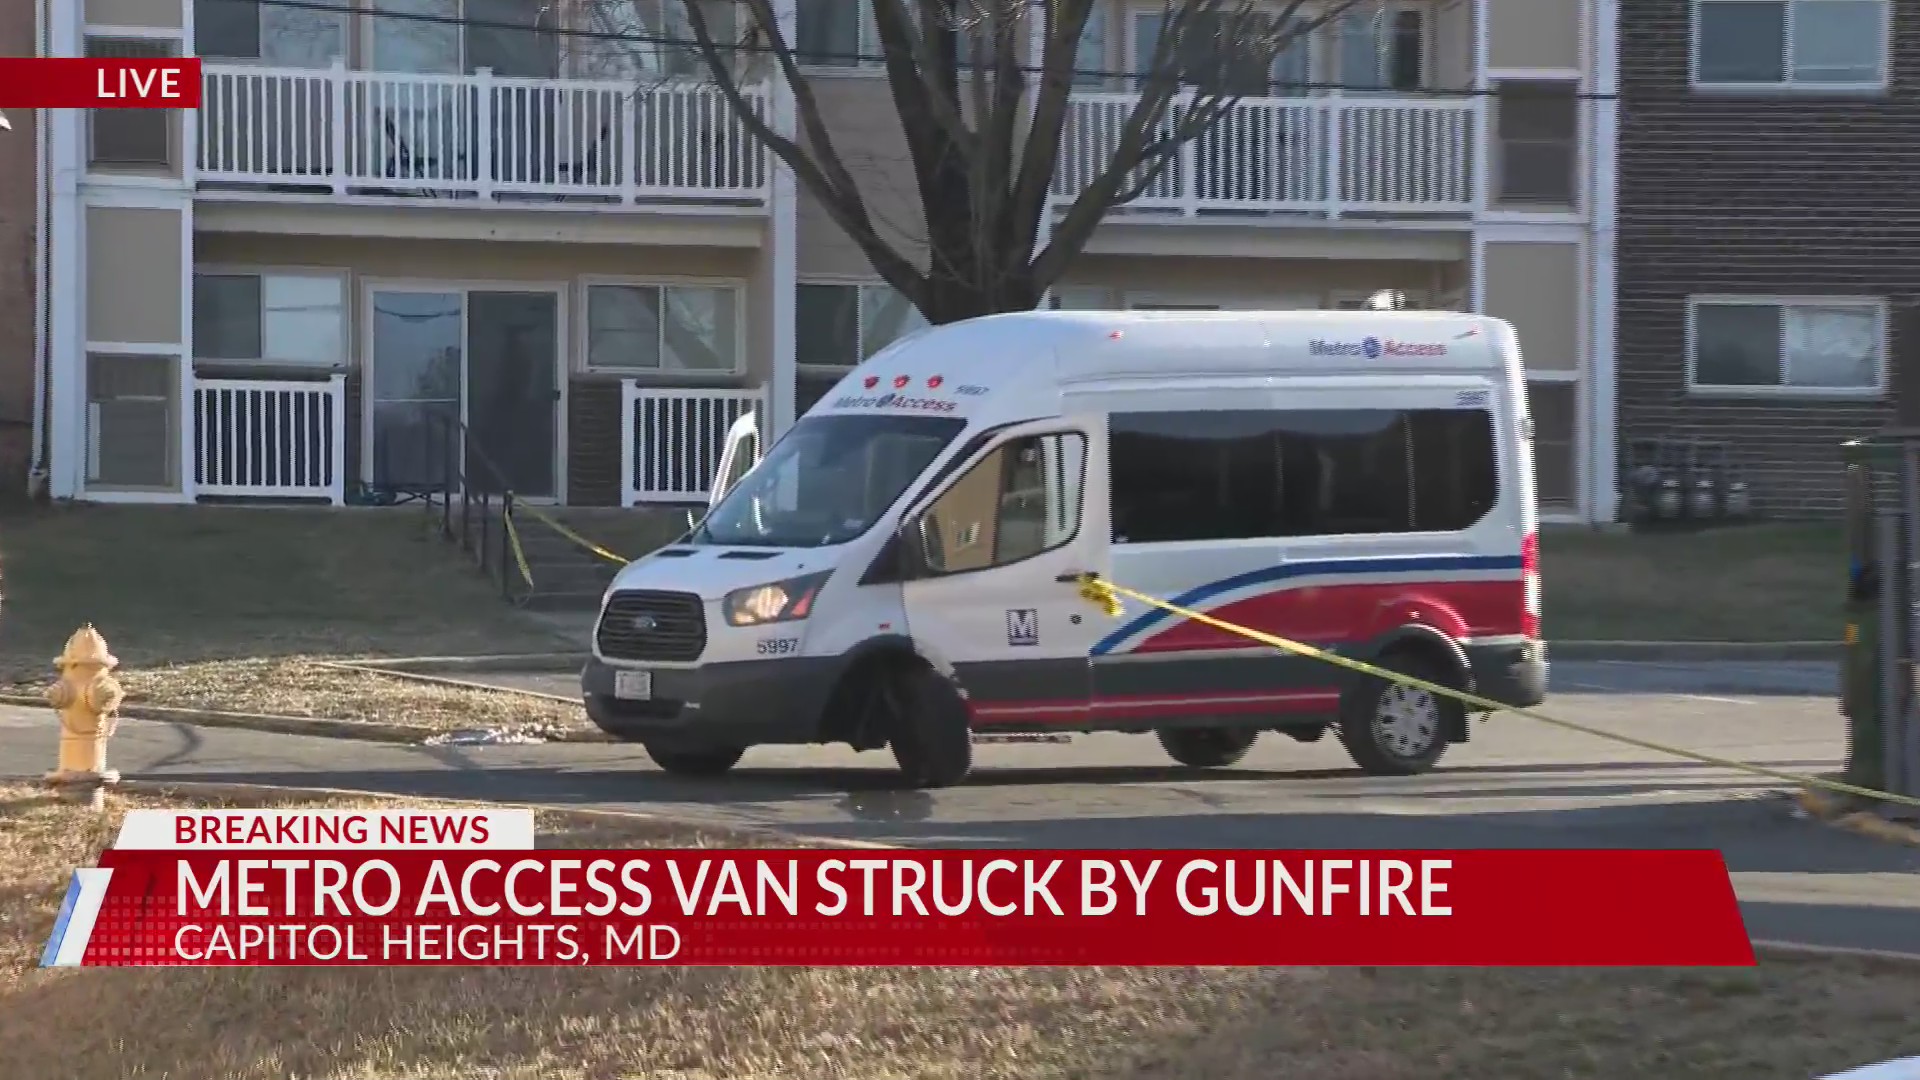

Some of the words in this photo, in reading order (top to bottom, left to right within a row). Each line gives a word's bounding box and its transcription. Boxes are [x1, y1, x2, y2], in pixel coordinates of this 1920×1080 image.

[1309, 338, 1362, 356] Metro
[1384, 338, 1447, 356] Access
[890, 395, 957, 412] Access
[1009, 610, 1038, 639] M
[756, 638, 799, 655] 5997
